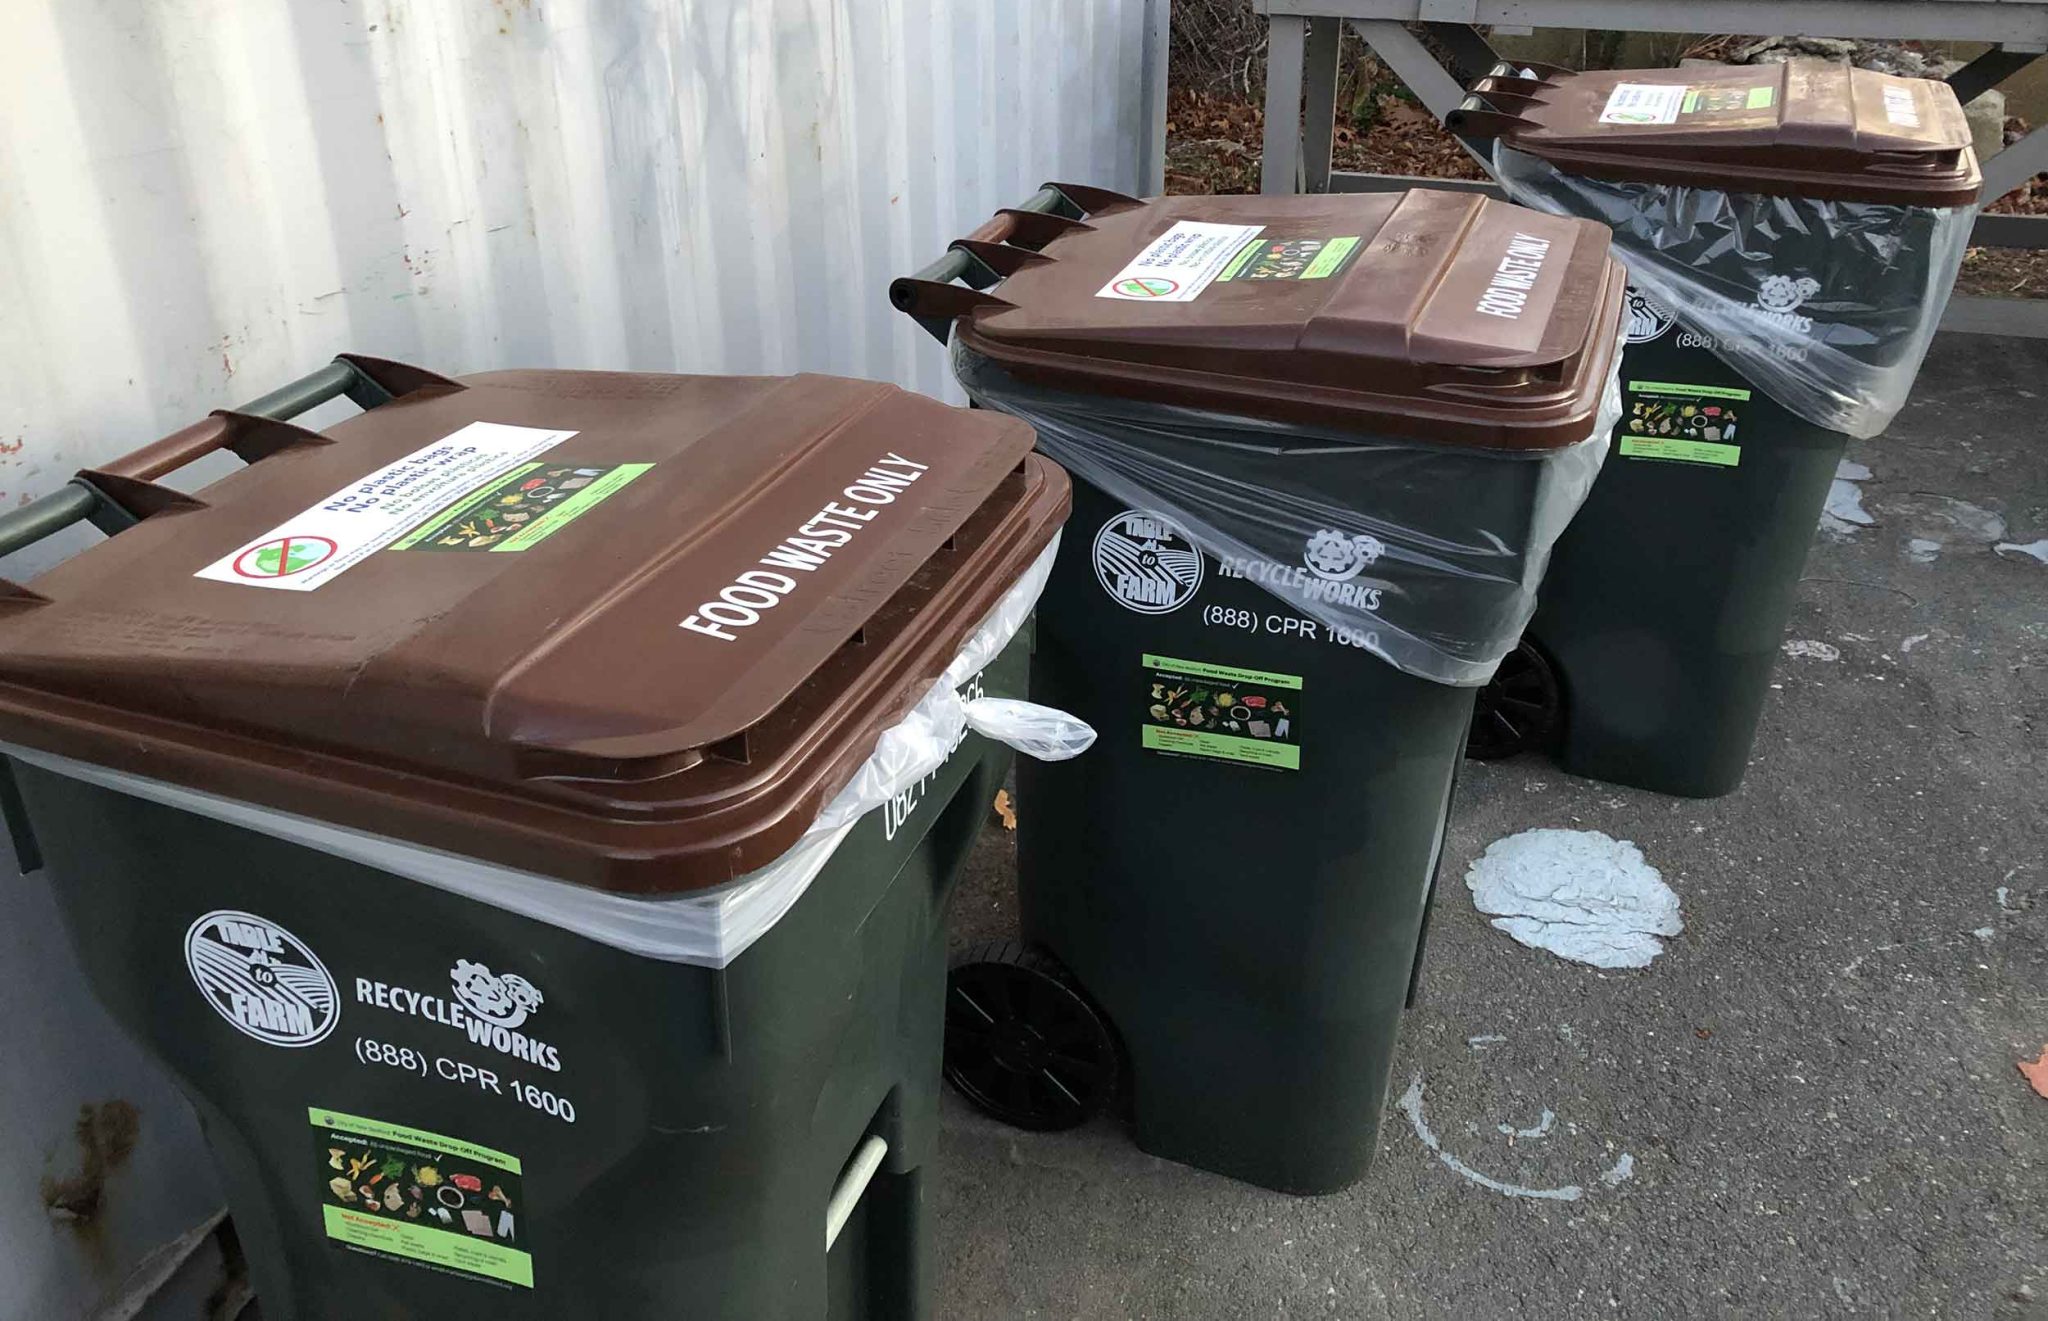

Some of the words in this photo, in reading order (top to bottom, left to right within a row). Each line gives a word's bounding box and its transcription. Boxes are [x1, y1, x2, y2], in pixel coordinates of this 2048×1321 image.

[1506, 231, 1552, 261] ONLY
[1490, 256, 1542, 290] WASTE
[1476, 287, 1527, 320] FOOD
[323, 495, 357, 511] No
[358, 465, 415, 495] plastic
[408, 444, 455, 466] bags
[346, 497, 380, 513] No
[380, 466, 436, 496] plastic
[434, 446, 478, 467] wrap
[679, 570, 797, 641] FOOD
[759, 501, 880, 572] WASTE
[843, 452, 929, 505] ONLY
[1141, 553, 1156, 566] to
[1117, 573, 1177, 606] FARM
[1203, 604, 1258, 634] (888)
[1265, 614, 1317, 640] CPR
[217, 920, 285, 954] TABLE
[254, 967, 274, 984] to
[230, 992, 315, 1036] FARM
[355, 1037, 428, 1077] (888)
[435, 1057, 503, 1095] CPR
[509, 1080, 576, 1123] 1600
[392, 1130, 413, 1140] Food
[413, 1134, 438, 1146] Waste
[473, 1150, 507, 1166] Program
